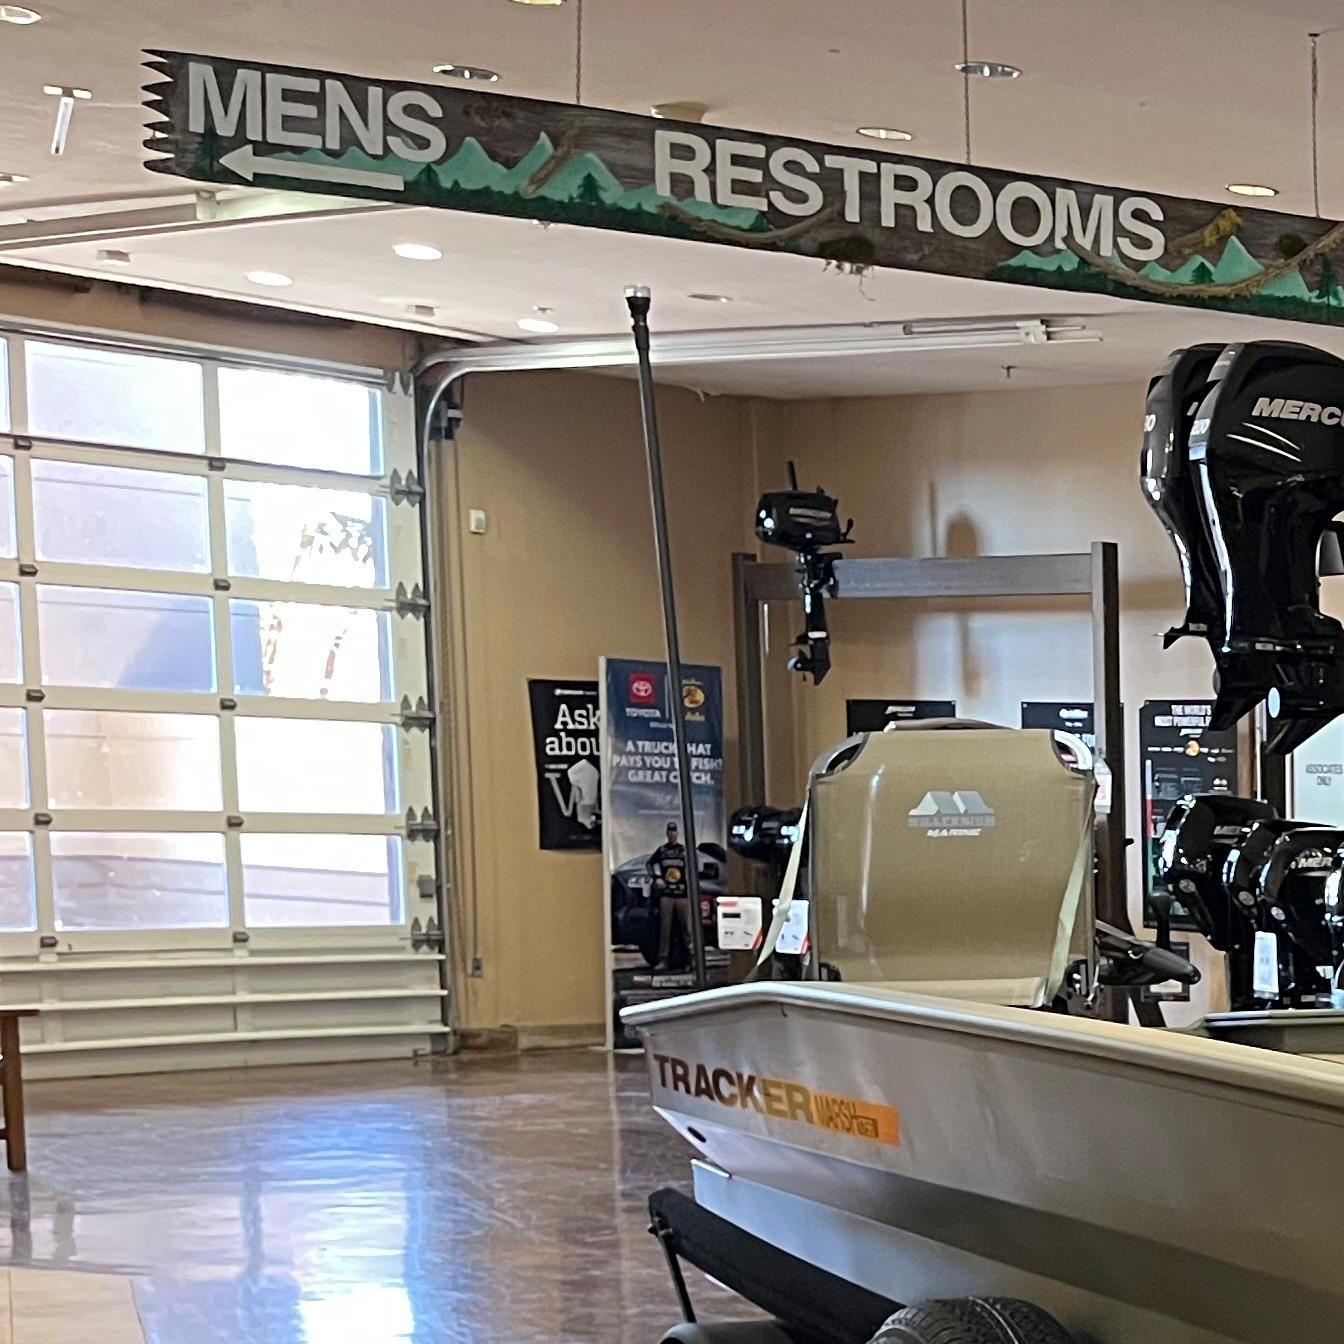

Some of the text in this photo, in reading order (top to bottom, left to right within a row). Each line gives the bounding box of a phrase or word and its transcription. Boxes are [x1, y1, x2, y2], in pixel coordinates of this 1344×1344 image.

[188, 61, 447, 163] MENS
[654, 130, 1165, 261] RESTROOMS
[554, 703, 600, 730] Ask
[545, 732, 600, 756] abou
[625, 741, 635, 754] A
[687, 743, 712, 756] HAT
[645, 757, 672, 768] YOU
[628, 770, 667, 783] GREAT
[653, 1052, 815, 1125] TRACKER
